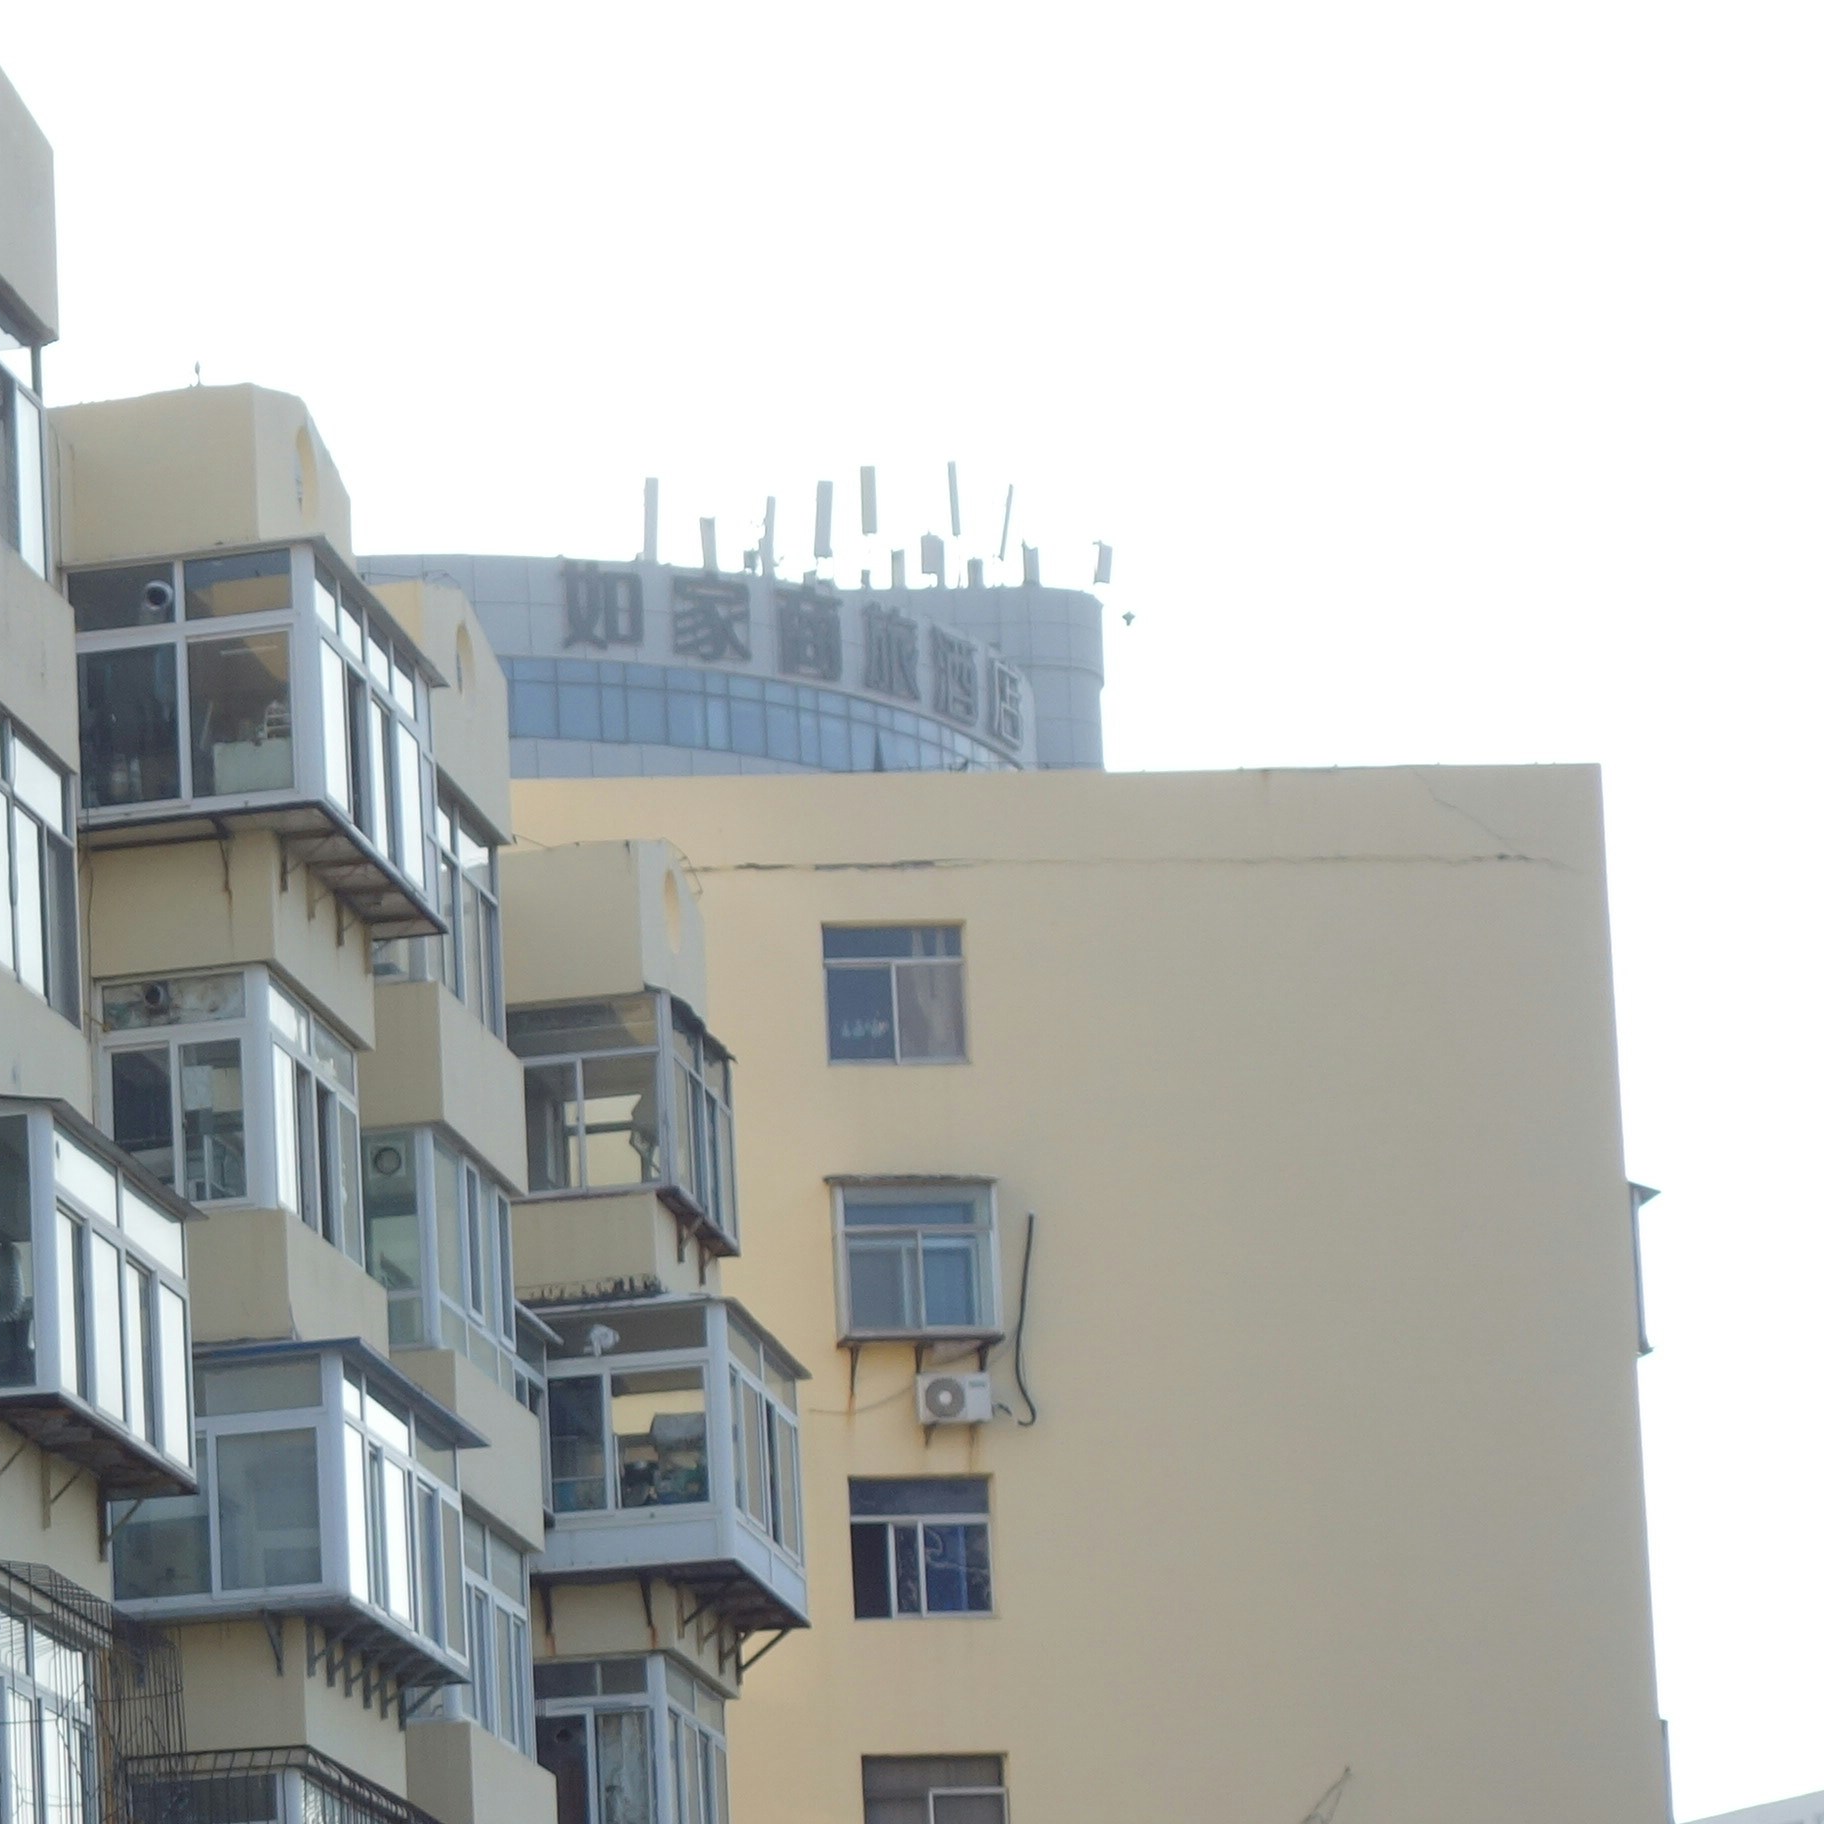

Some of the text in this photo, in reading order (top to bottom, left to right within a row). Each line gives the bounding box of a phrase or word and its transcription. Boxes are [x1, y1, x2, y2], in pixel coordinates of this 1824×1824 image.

[561, 560, 1025, 750] 如家商旅酒店
